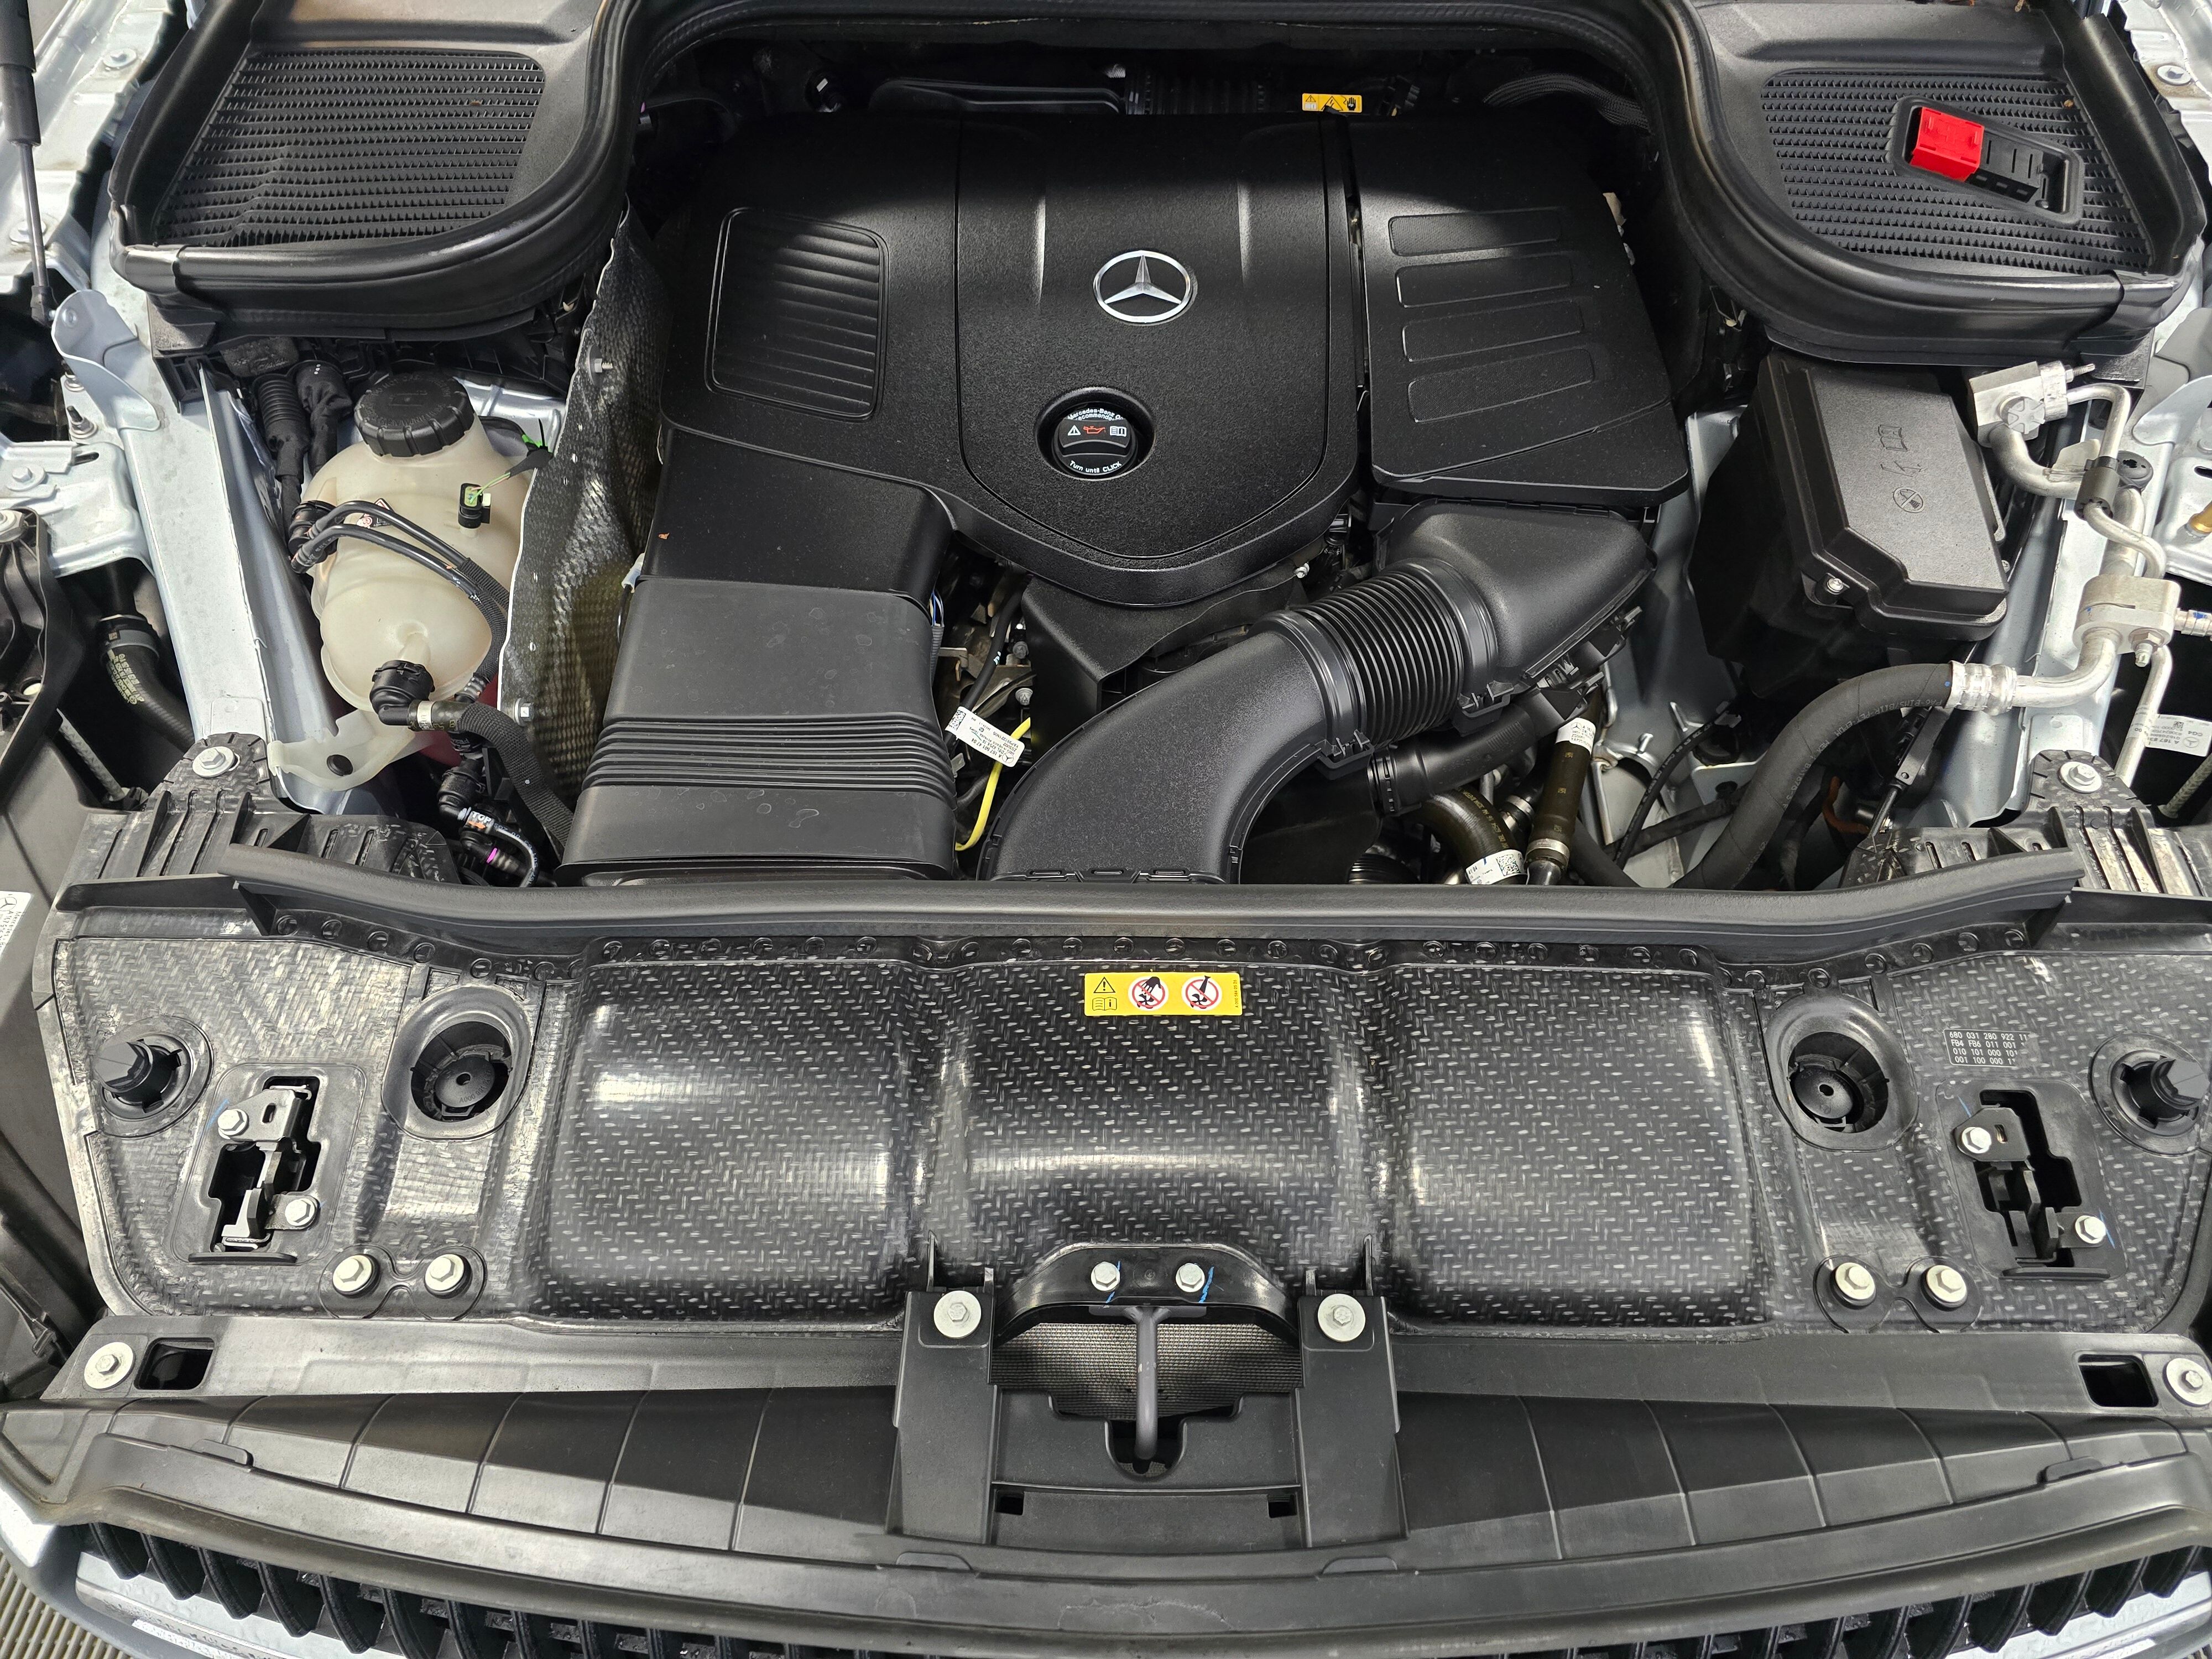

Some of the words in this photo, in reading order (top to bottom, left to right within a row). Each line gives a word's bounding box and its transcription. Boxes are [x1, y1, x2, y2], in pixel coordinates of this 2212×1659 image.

[1067, 409, 1115, 420] Mercedes-Benz
[1070, 461, 1083, 471] Turn
[1103, 461, 1121, 472] CLICK
